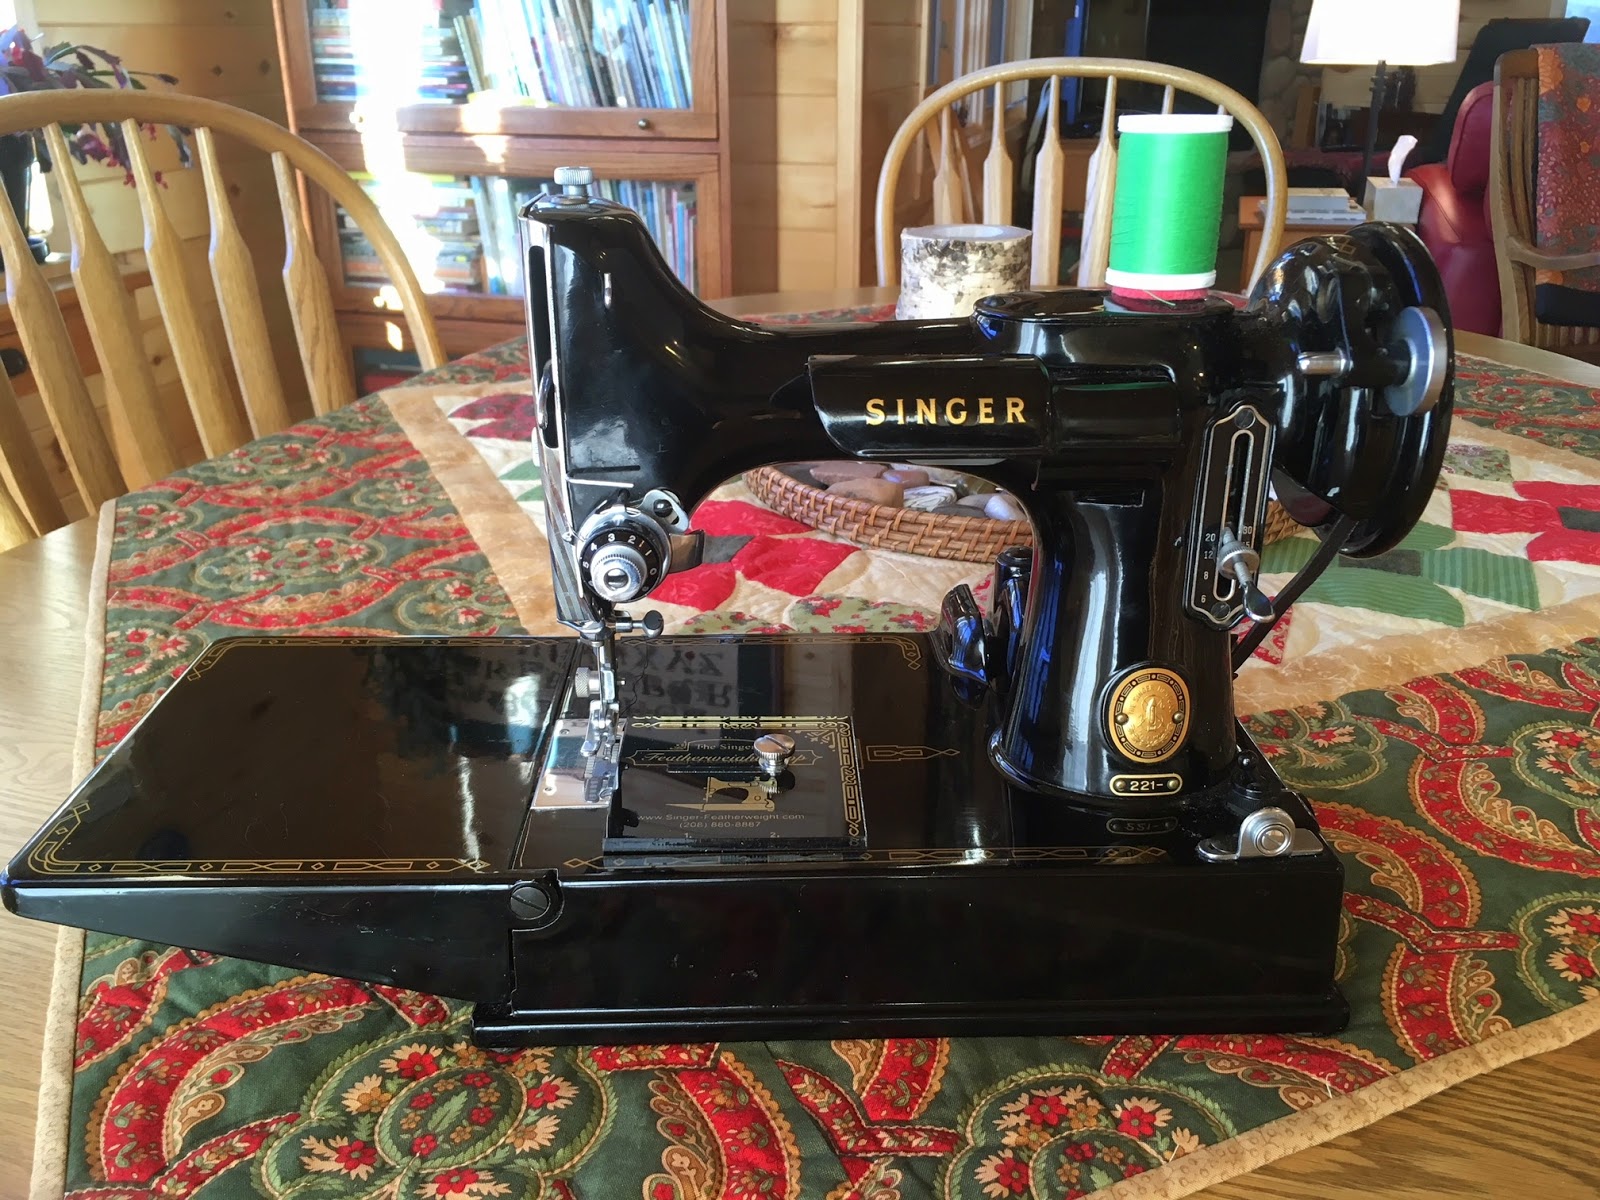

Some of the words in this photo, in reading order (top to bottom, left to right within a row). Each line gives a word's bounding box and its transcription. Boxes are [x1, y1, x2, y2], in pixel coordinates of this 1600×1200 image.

[865, 396, 1026, 426] SINGER
[1242, 526, 1253, 535] 30
[608, 533, 615, 542] 3
[628, 535, 636, 544] 2
[1205, 533, 1216, 541] 20
[1204, 550, 1214, 560] 12
[1203, 571, 1209, 580] 8
[1200, 595, 1207, 603] 6
[697, 743, 716, 751] The
[1130, 780, 1164, 791] 221-
[679, 821, 708, 829] (208)
[710, 820, 762, 829] 880-8887
